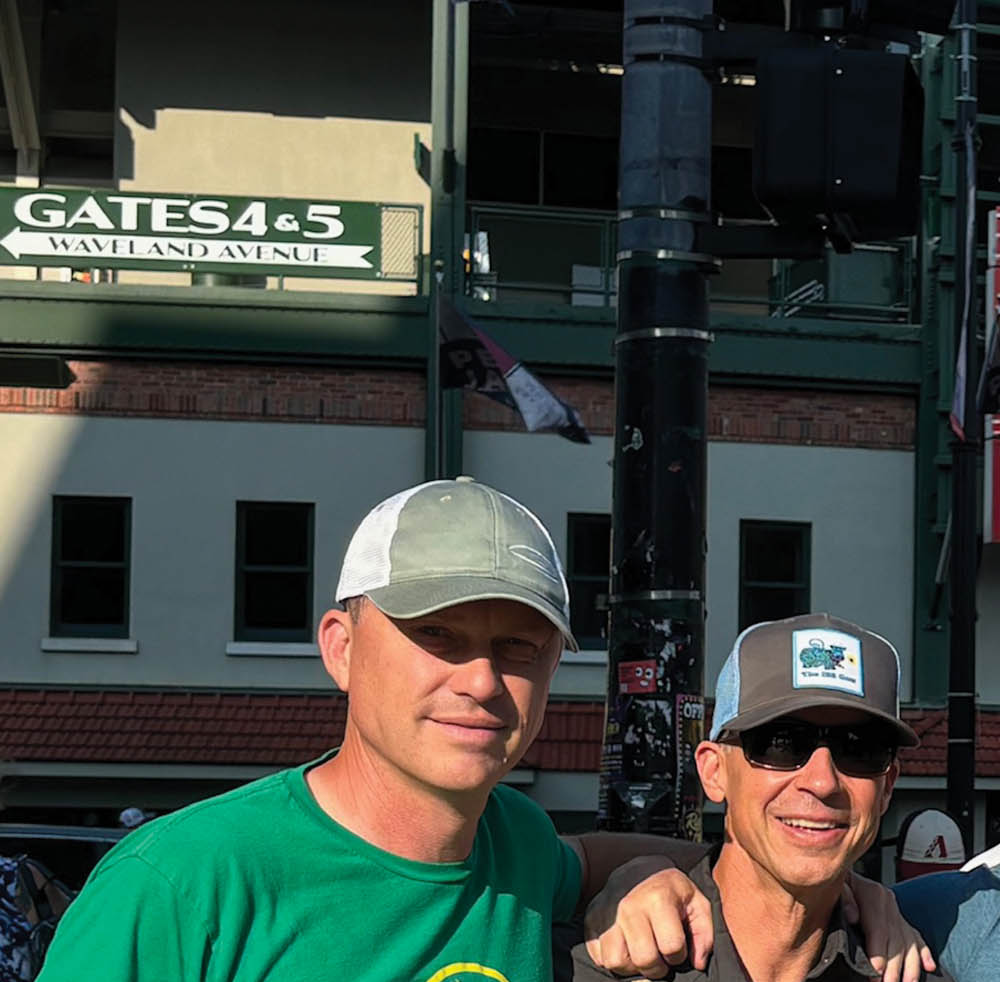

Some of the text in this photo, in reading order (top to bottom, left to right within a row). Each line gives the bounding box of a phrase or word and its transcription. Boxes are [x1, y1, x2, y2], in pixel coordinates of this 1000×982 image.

[13, 192, 230, 235] GATES
[49, 236, 329, 263] WAVELAND AVENUE
